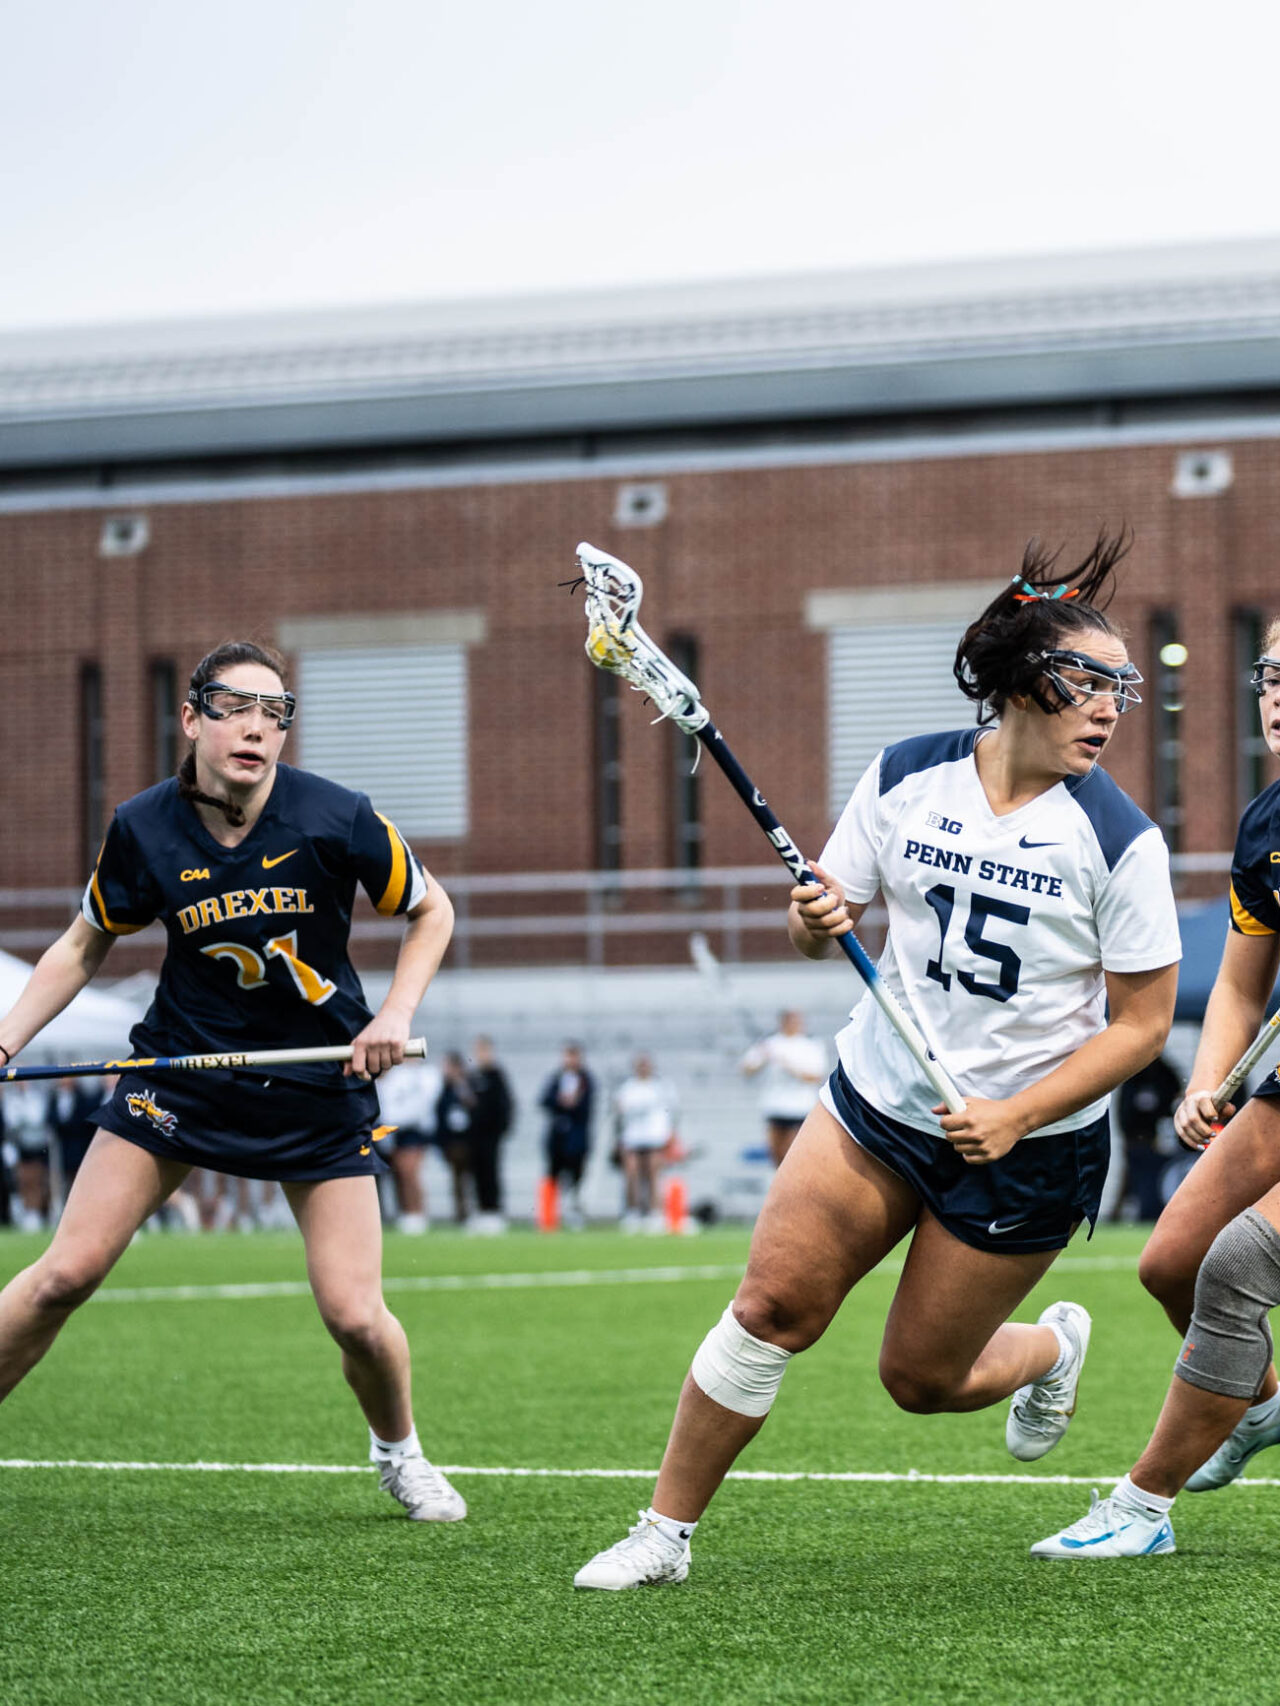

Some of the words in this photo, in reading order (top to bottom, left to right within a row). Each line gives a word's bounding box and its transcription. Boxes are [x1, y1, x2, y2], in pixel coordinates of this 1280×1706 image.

[180, 868, 211, 882] CAA
[766, 826, 813, 879] STX
[903, 839, 973, 875] PENN
[978, 860, 1063, 898] STATE
[176, 887, 315, 934] DREXEL
[924, 883, 1032, 1003] 15
